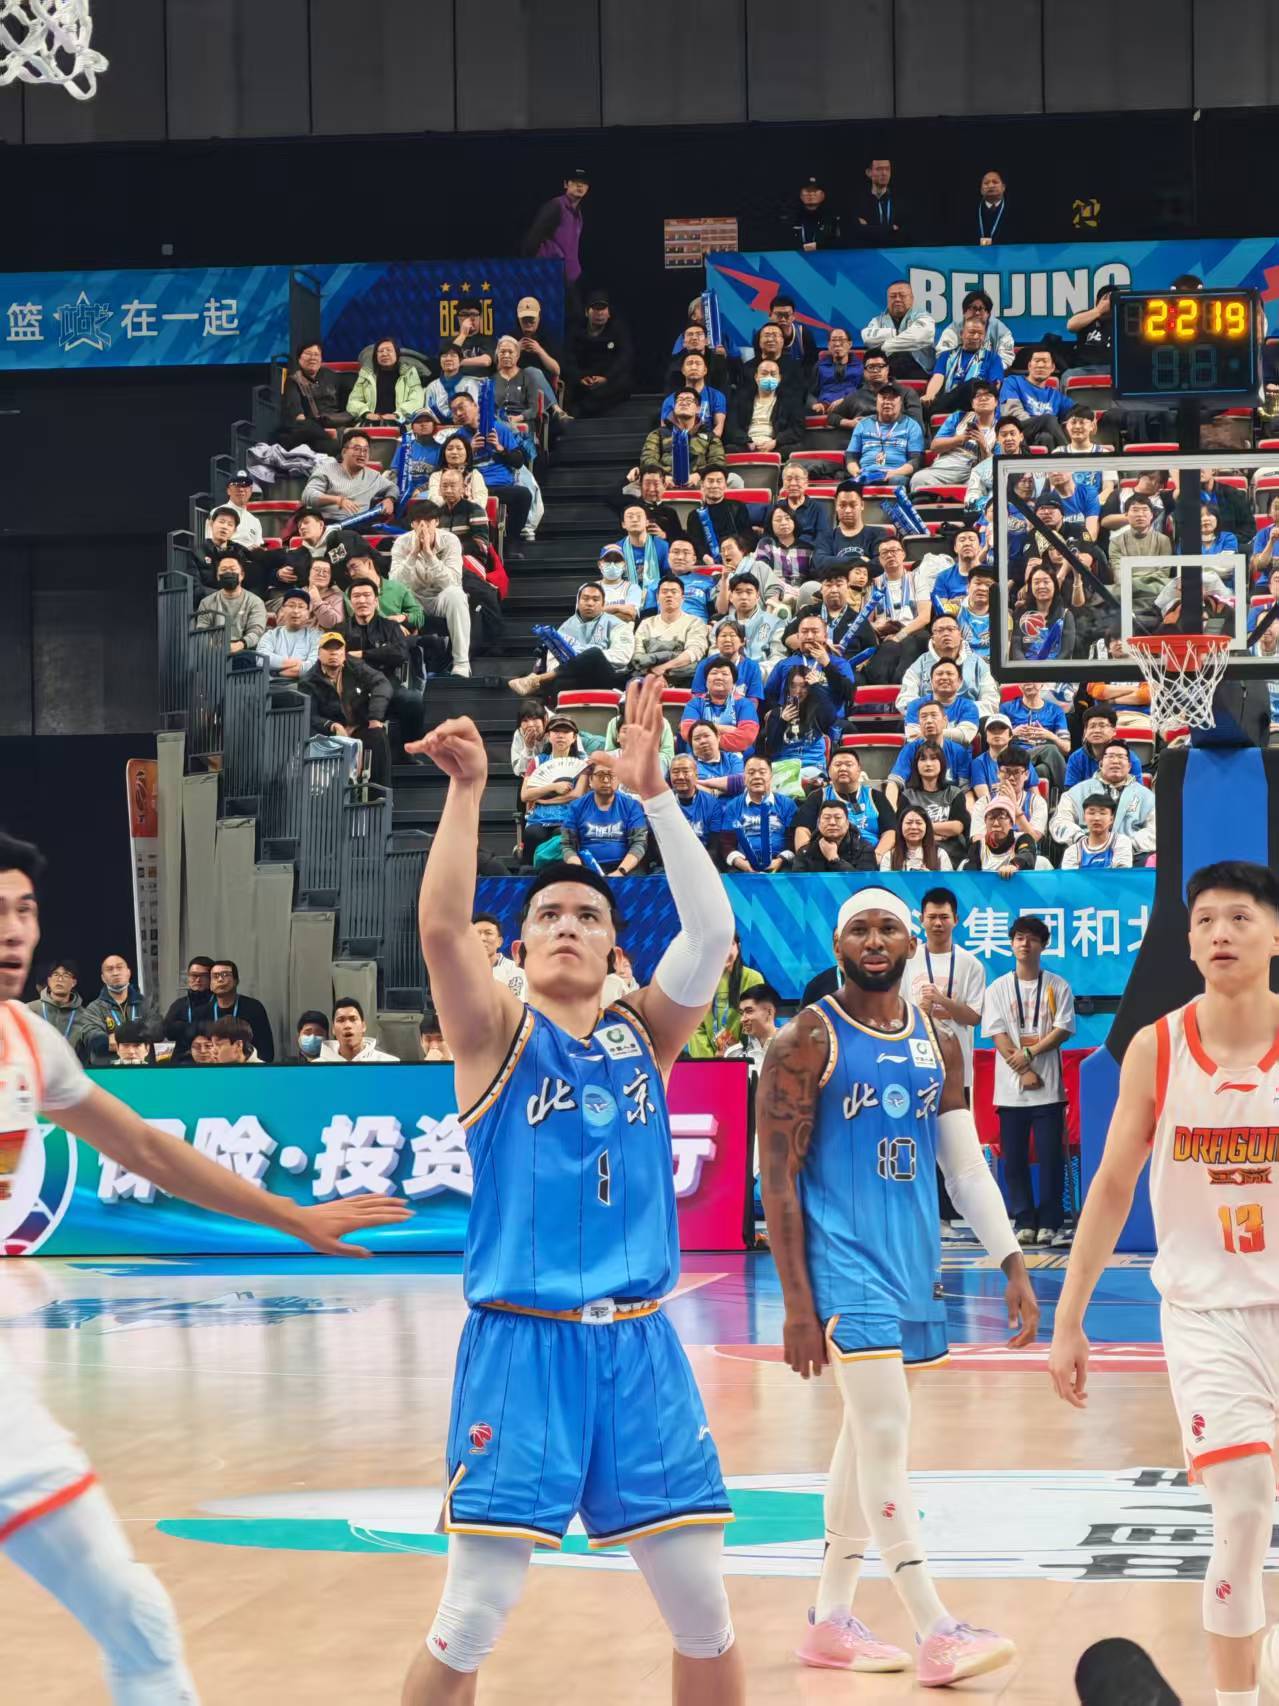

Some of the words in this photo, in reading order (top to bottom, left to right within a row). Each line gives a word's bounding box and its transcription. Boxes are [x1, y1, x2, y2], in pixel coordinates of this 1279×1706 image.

[909, 905, 1150, 958] 集团和
[527, 1067, 655, 1126] 北京
[843, 1076, 940, 1120] 北京
[597, 1149, 611, 1207] 1
[877, 1137, 917, 1182] 10
[1218, 1203, 1266, 1254] 13
